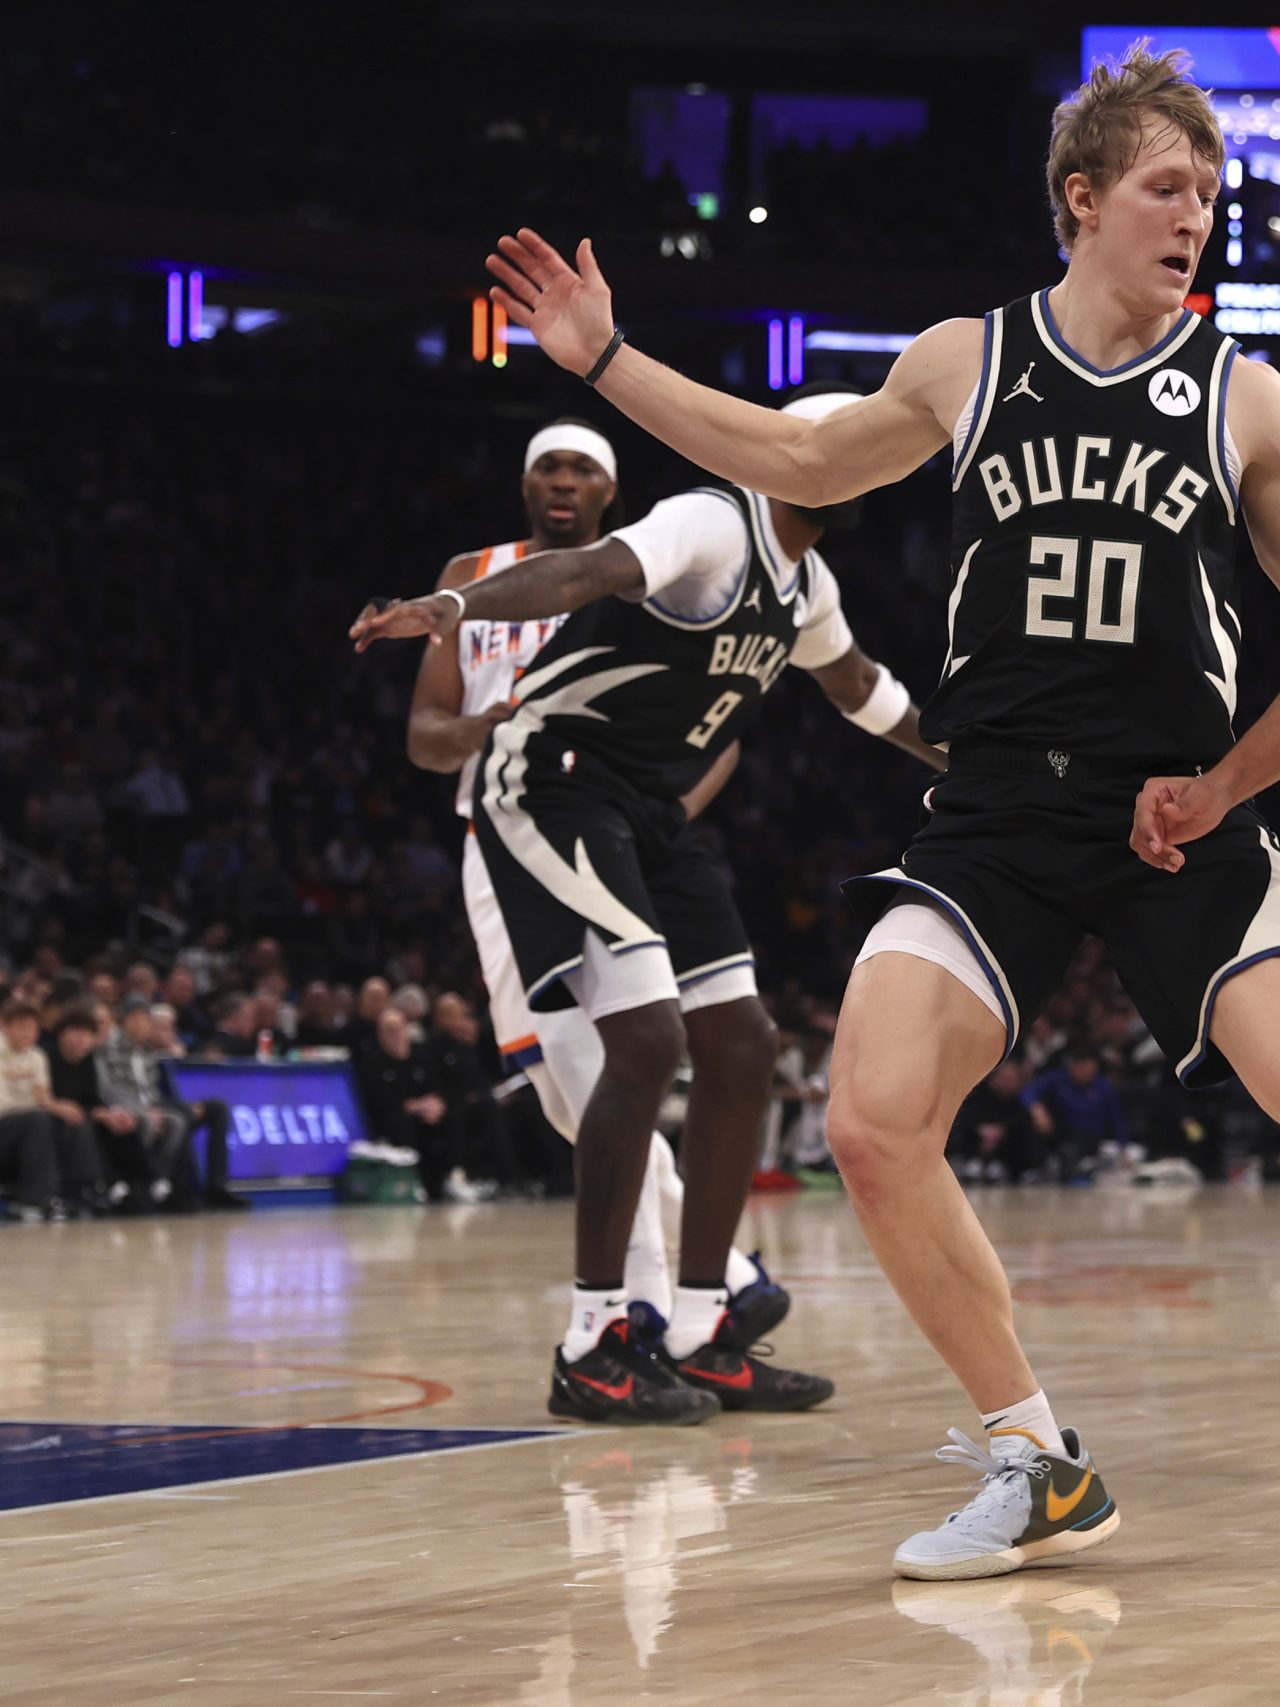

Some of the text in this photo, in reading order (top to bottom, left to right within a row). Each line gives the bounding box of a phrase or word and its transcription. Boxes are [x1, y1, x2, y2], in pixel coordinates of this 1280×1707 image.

[978, 434, 1211, 534] BUCKS
[1025, 535, 1144, 644] 20
[685, 690, 743, 750] 9
[231, 1103, 350, 1145] DELTA
